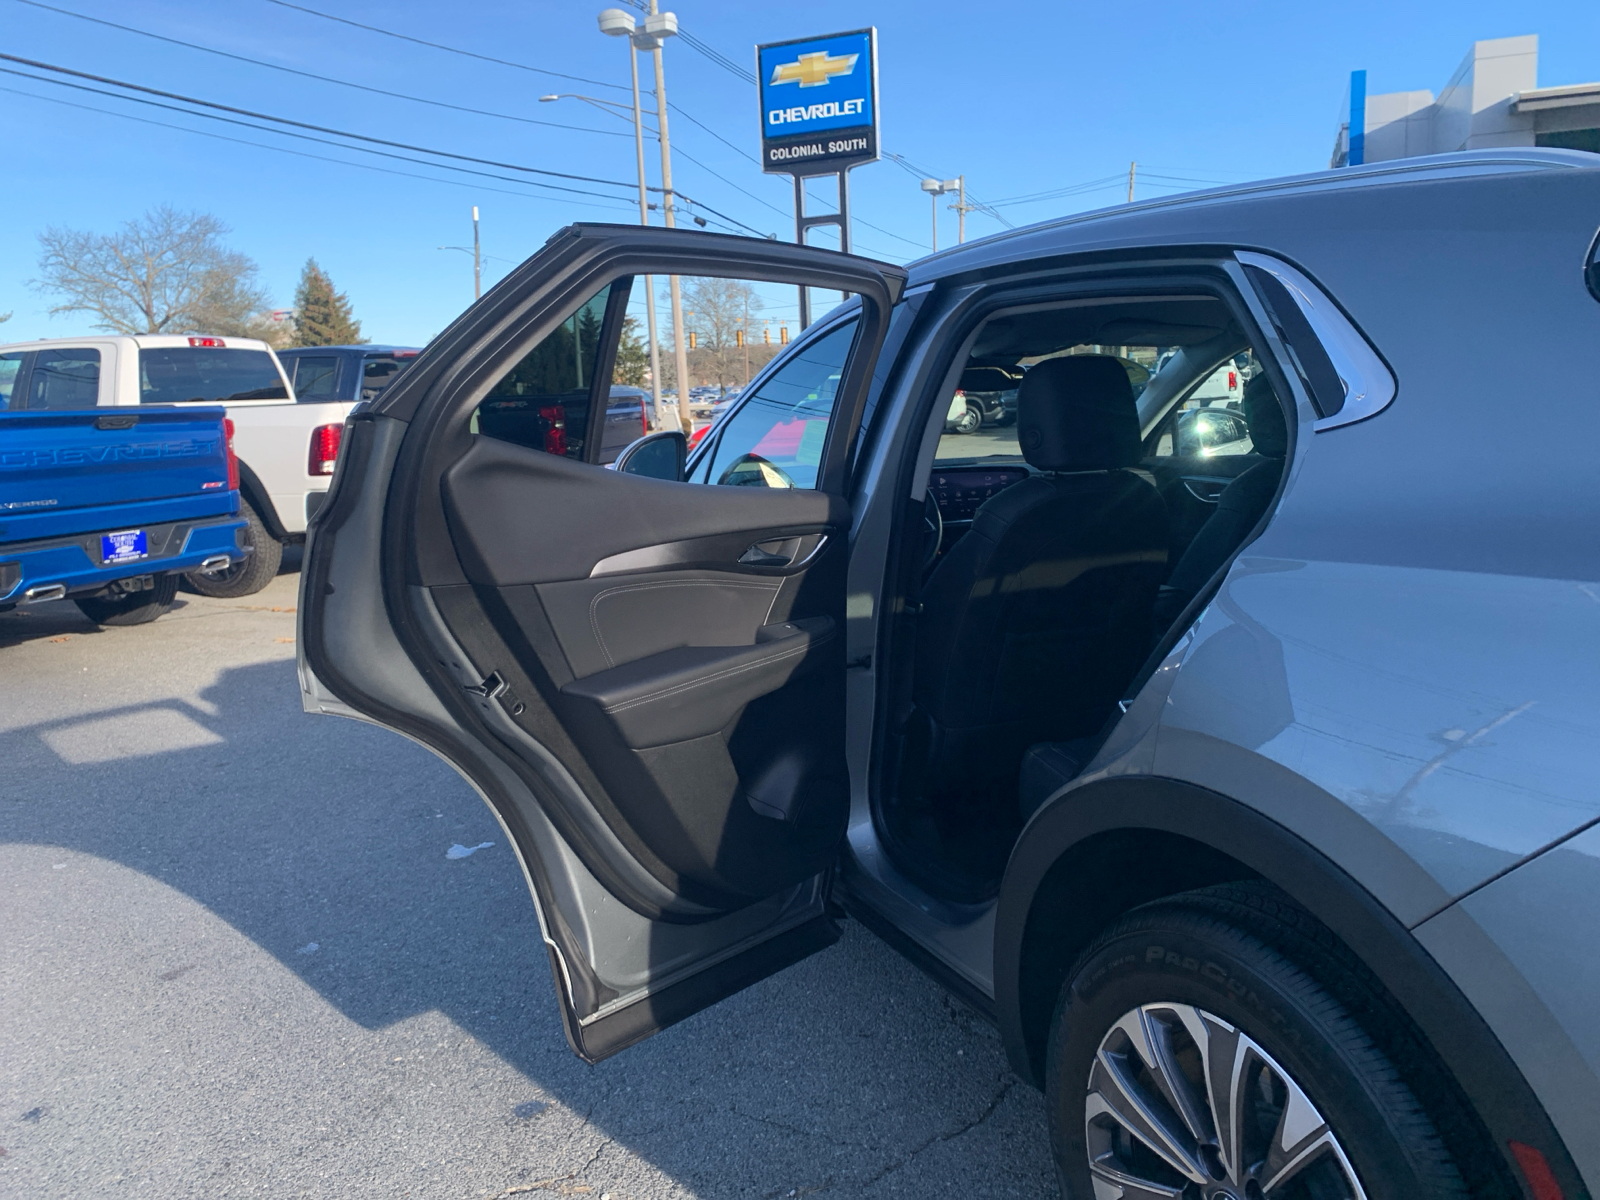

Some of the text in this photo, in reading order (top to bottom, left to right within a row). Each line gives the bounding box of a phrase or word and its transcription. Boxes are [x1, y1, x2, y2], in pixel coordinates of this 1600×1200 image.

[769, 98, 865, 125] CHEVROLET
[770, 138, 867, 161] COLONIAL SOUTH
[2, 440, 216, 467] CHEVROLET
